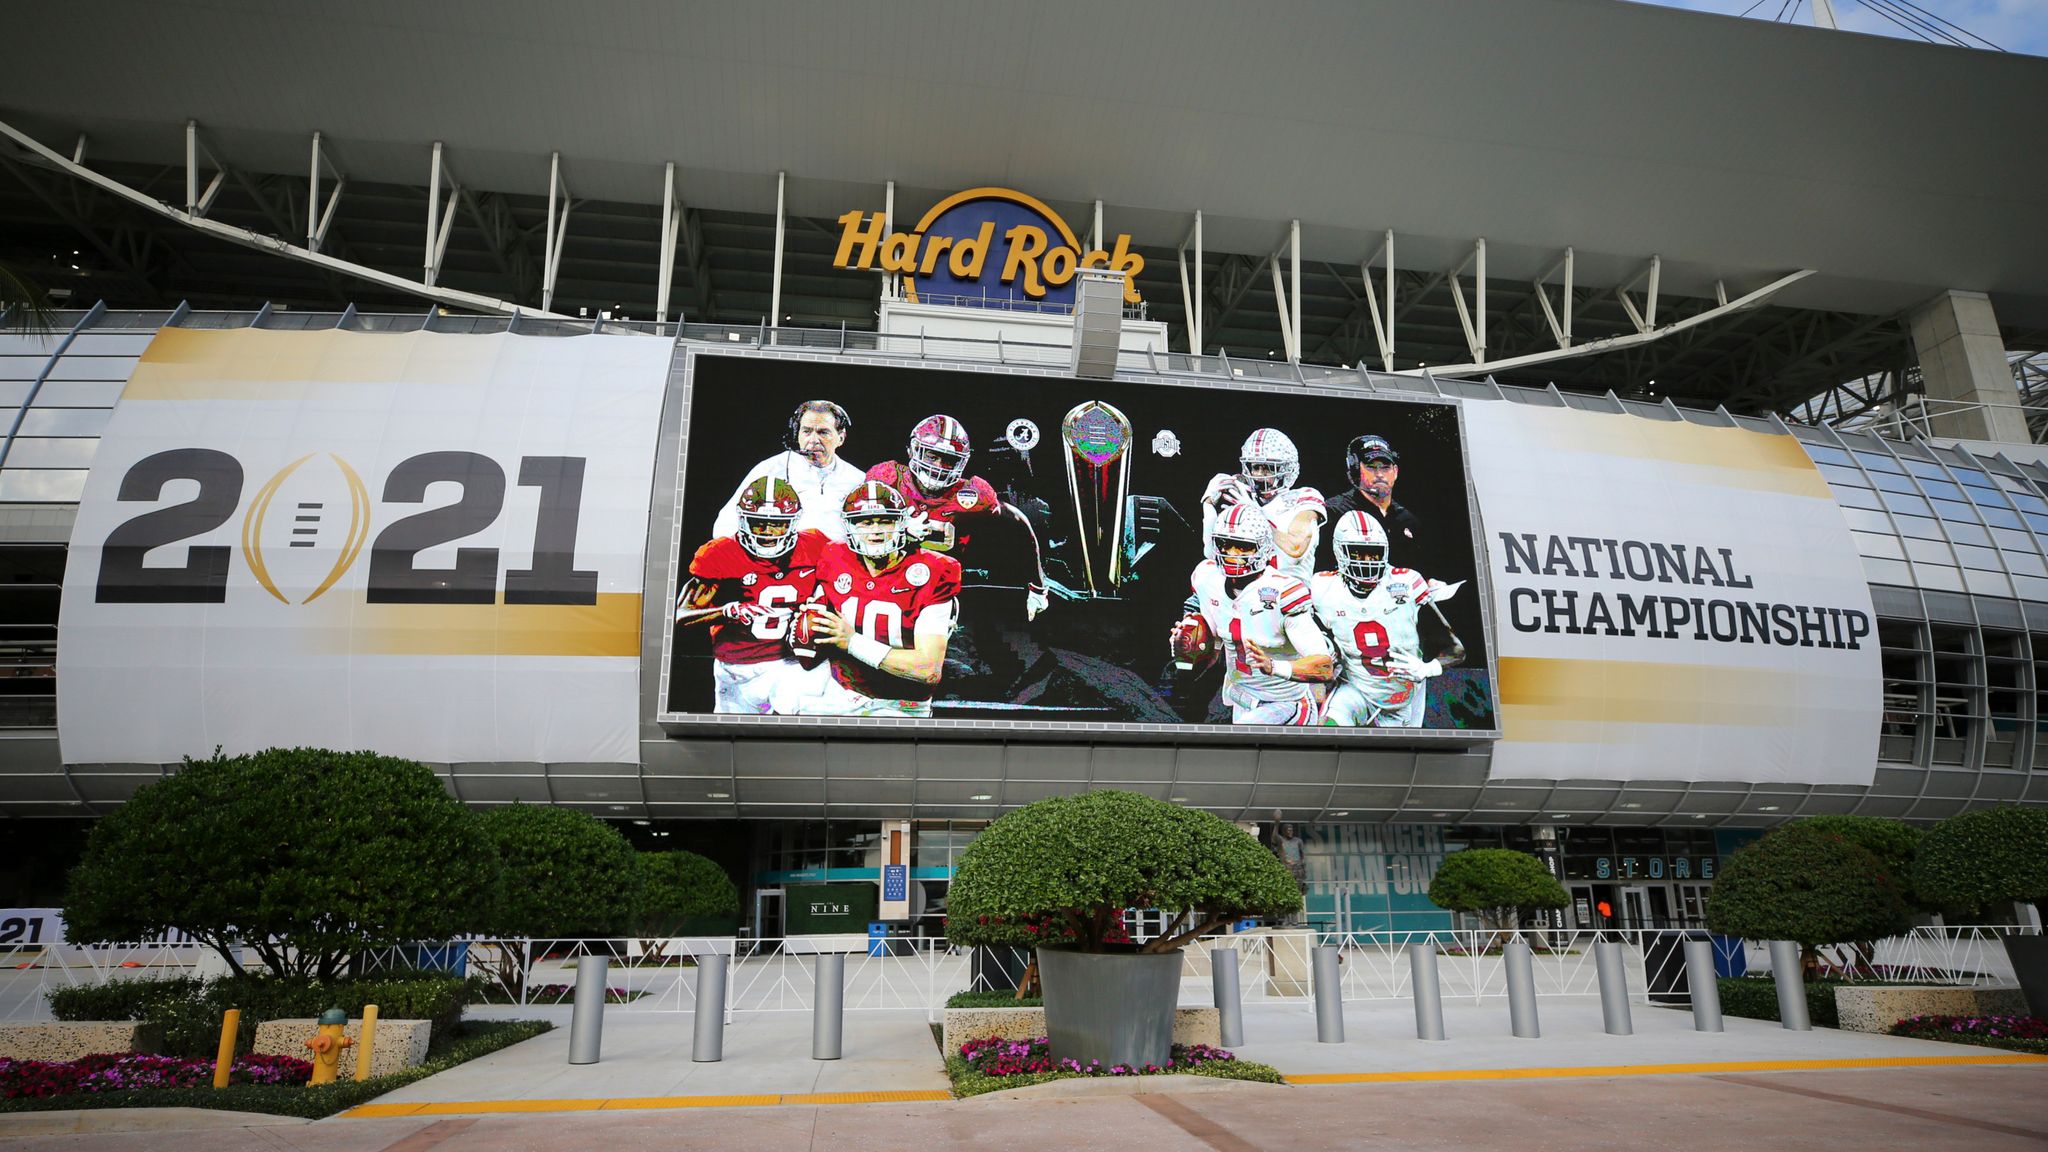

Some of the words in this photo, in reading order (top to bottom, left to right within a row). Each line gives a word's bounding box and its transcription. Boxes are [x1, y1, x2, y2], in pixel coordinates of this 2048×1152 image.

[833, 210, 996, 278] Hard
[1001, 224, 1145, 303] Rock
[1499, 532, 1753, 589] NATIONAL
[751, 585, 798, 640] 6
[841, 596, 903, 648] 10
[1510, 587, 1870, 650] CHAMPIONSHIP
[1229, 618, 1252, 675] 1
[1353, 620, 1391, 677] 8
[1306, 855, 1388, 895] THAN
[1597, 858, 1713, 878] STORE
